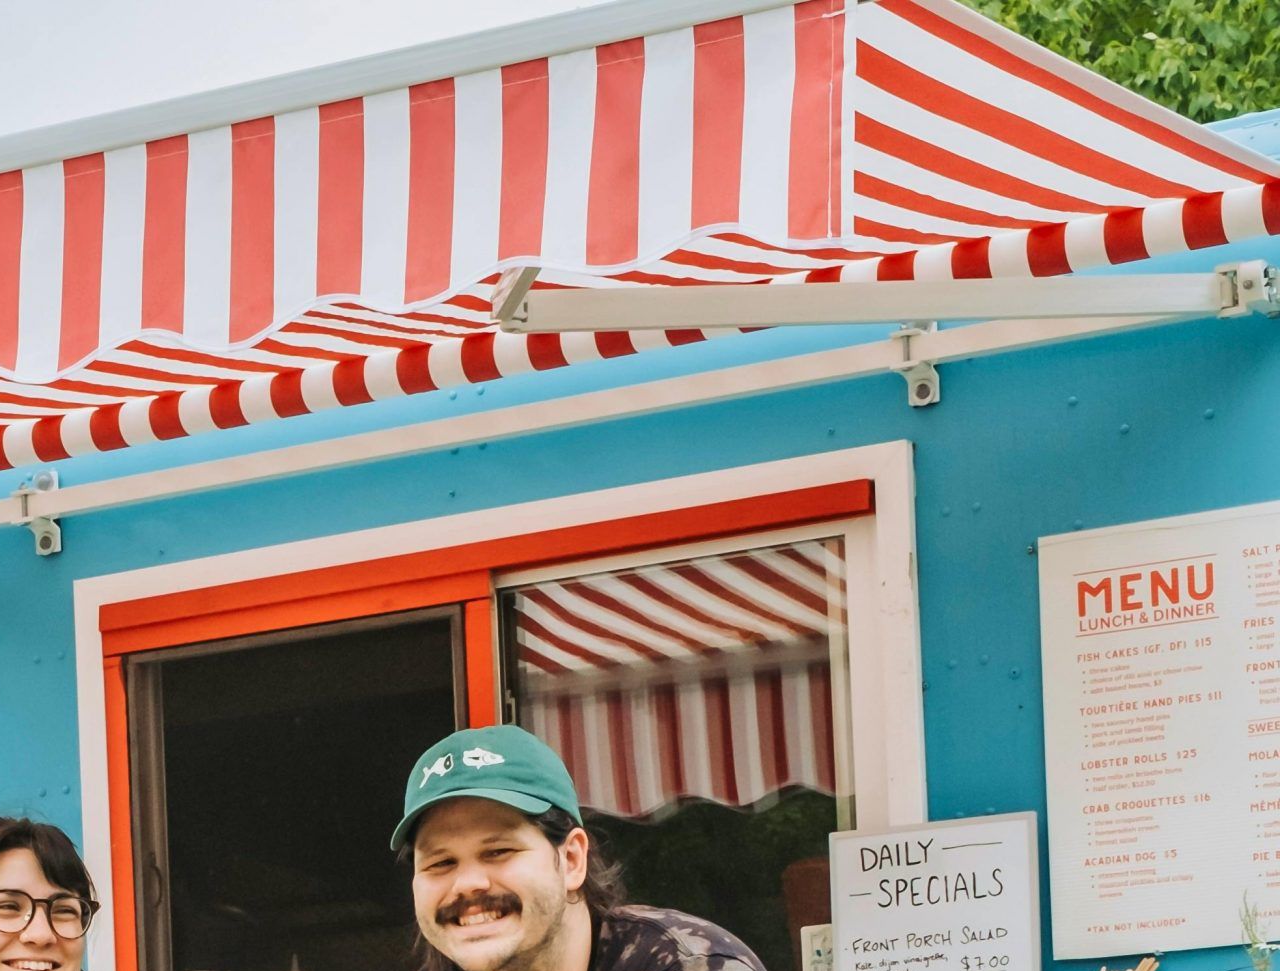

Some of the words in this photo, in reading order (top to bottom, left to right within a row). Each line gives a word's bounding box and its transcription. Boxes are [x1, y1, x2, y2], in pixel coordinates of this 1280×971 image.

[1077, 562, 1214, 617] MENU
[1079, 613, 1134, 632] LUNCH
[1139, 611, 1149, 624] &
[1154, 602, 1215, 622] DINNER
[1244, 616, 1275, 629] FRIES
[1077, 651, 1100, 664] FISH
[1104, 646, 1139, 660] CAKES
[1195, 636, 1212, 648] $15
[1144, 697, 1173, 709] HAND
[1178, 693, 1202, 705] PIES
[1248, 720, 1280, 735] SWEE
[1081, 756, 1128, 771] LOBSTER
[1134, 752, 1168, 765] ROLLS
[1177, 748, 1197, 760] $25
[1248, 749, 1280, 762] MOLA
[1082, 803, 1110, 815] CRAB
[1115, 795, 1186, 811] CROQUETTES
[860, 838, 934, 872] DAILY
[1084, 854, 1130, 867] ACADIAN
[1135, 851, 1156, 862] DOG
[1164, 848, 1178, 859] $5
[877, 868, 1004, 908] SPECIALS
[1114, 923, 1132, 932] NOT
[852, 938, 899, 954] FRONT
[906, 930, 952, 949] PORCH
[960, 925, 1008, 944] SALAD
